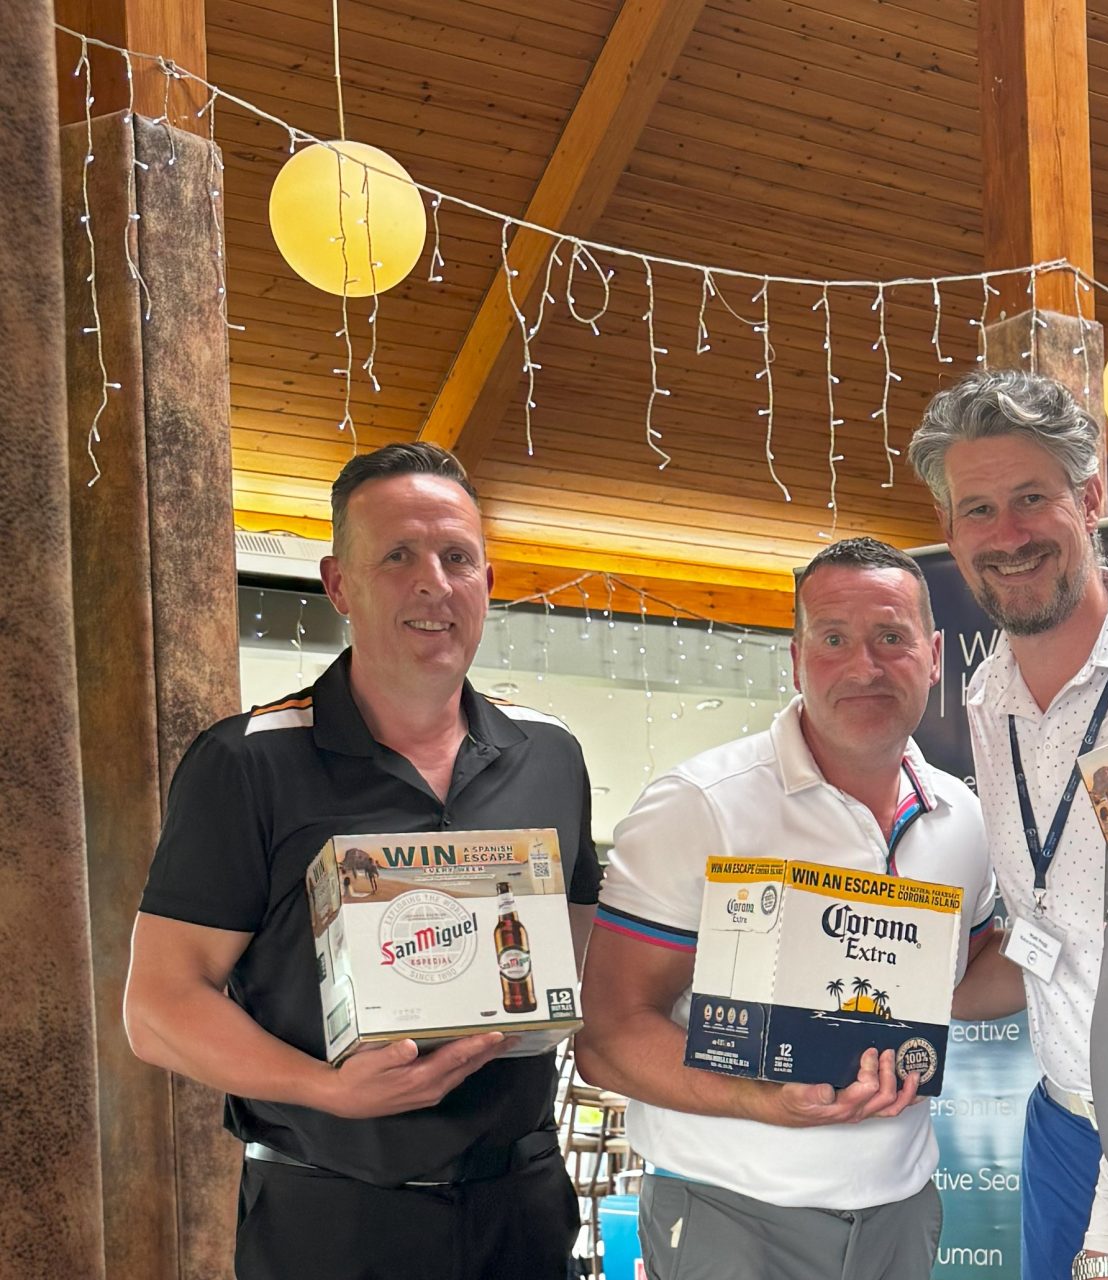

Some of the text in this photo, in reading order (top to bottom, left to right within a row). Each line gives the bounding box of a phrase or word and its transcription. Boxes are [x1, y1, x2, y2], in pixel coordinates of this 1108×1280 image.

[382, 845, 457, 867] WIN
[472, 845, 513, 853] SPANISH
[464, 853, 514, 863] ESCAPE
[711, 863, 722, 873] WIN
[732, 863, 755, 875] ESCAPE
[792, 867, 896, 899] WIN AN ESCAPE
[898, 891, 960, 908] CORONA ISLAND
[821, 903, 918, 943] Corona
[845, 937, 896, 965] Extra
[410, 957, 452, 966] ESPECIAL
[550, 991, 572, 1005] 12
[780, 1043, 793, 1057] 12
[905, 1051, 928, 1065] 100%
[931, 1168, 973, 1191] tive
